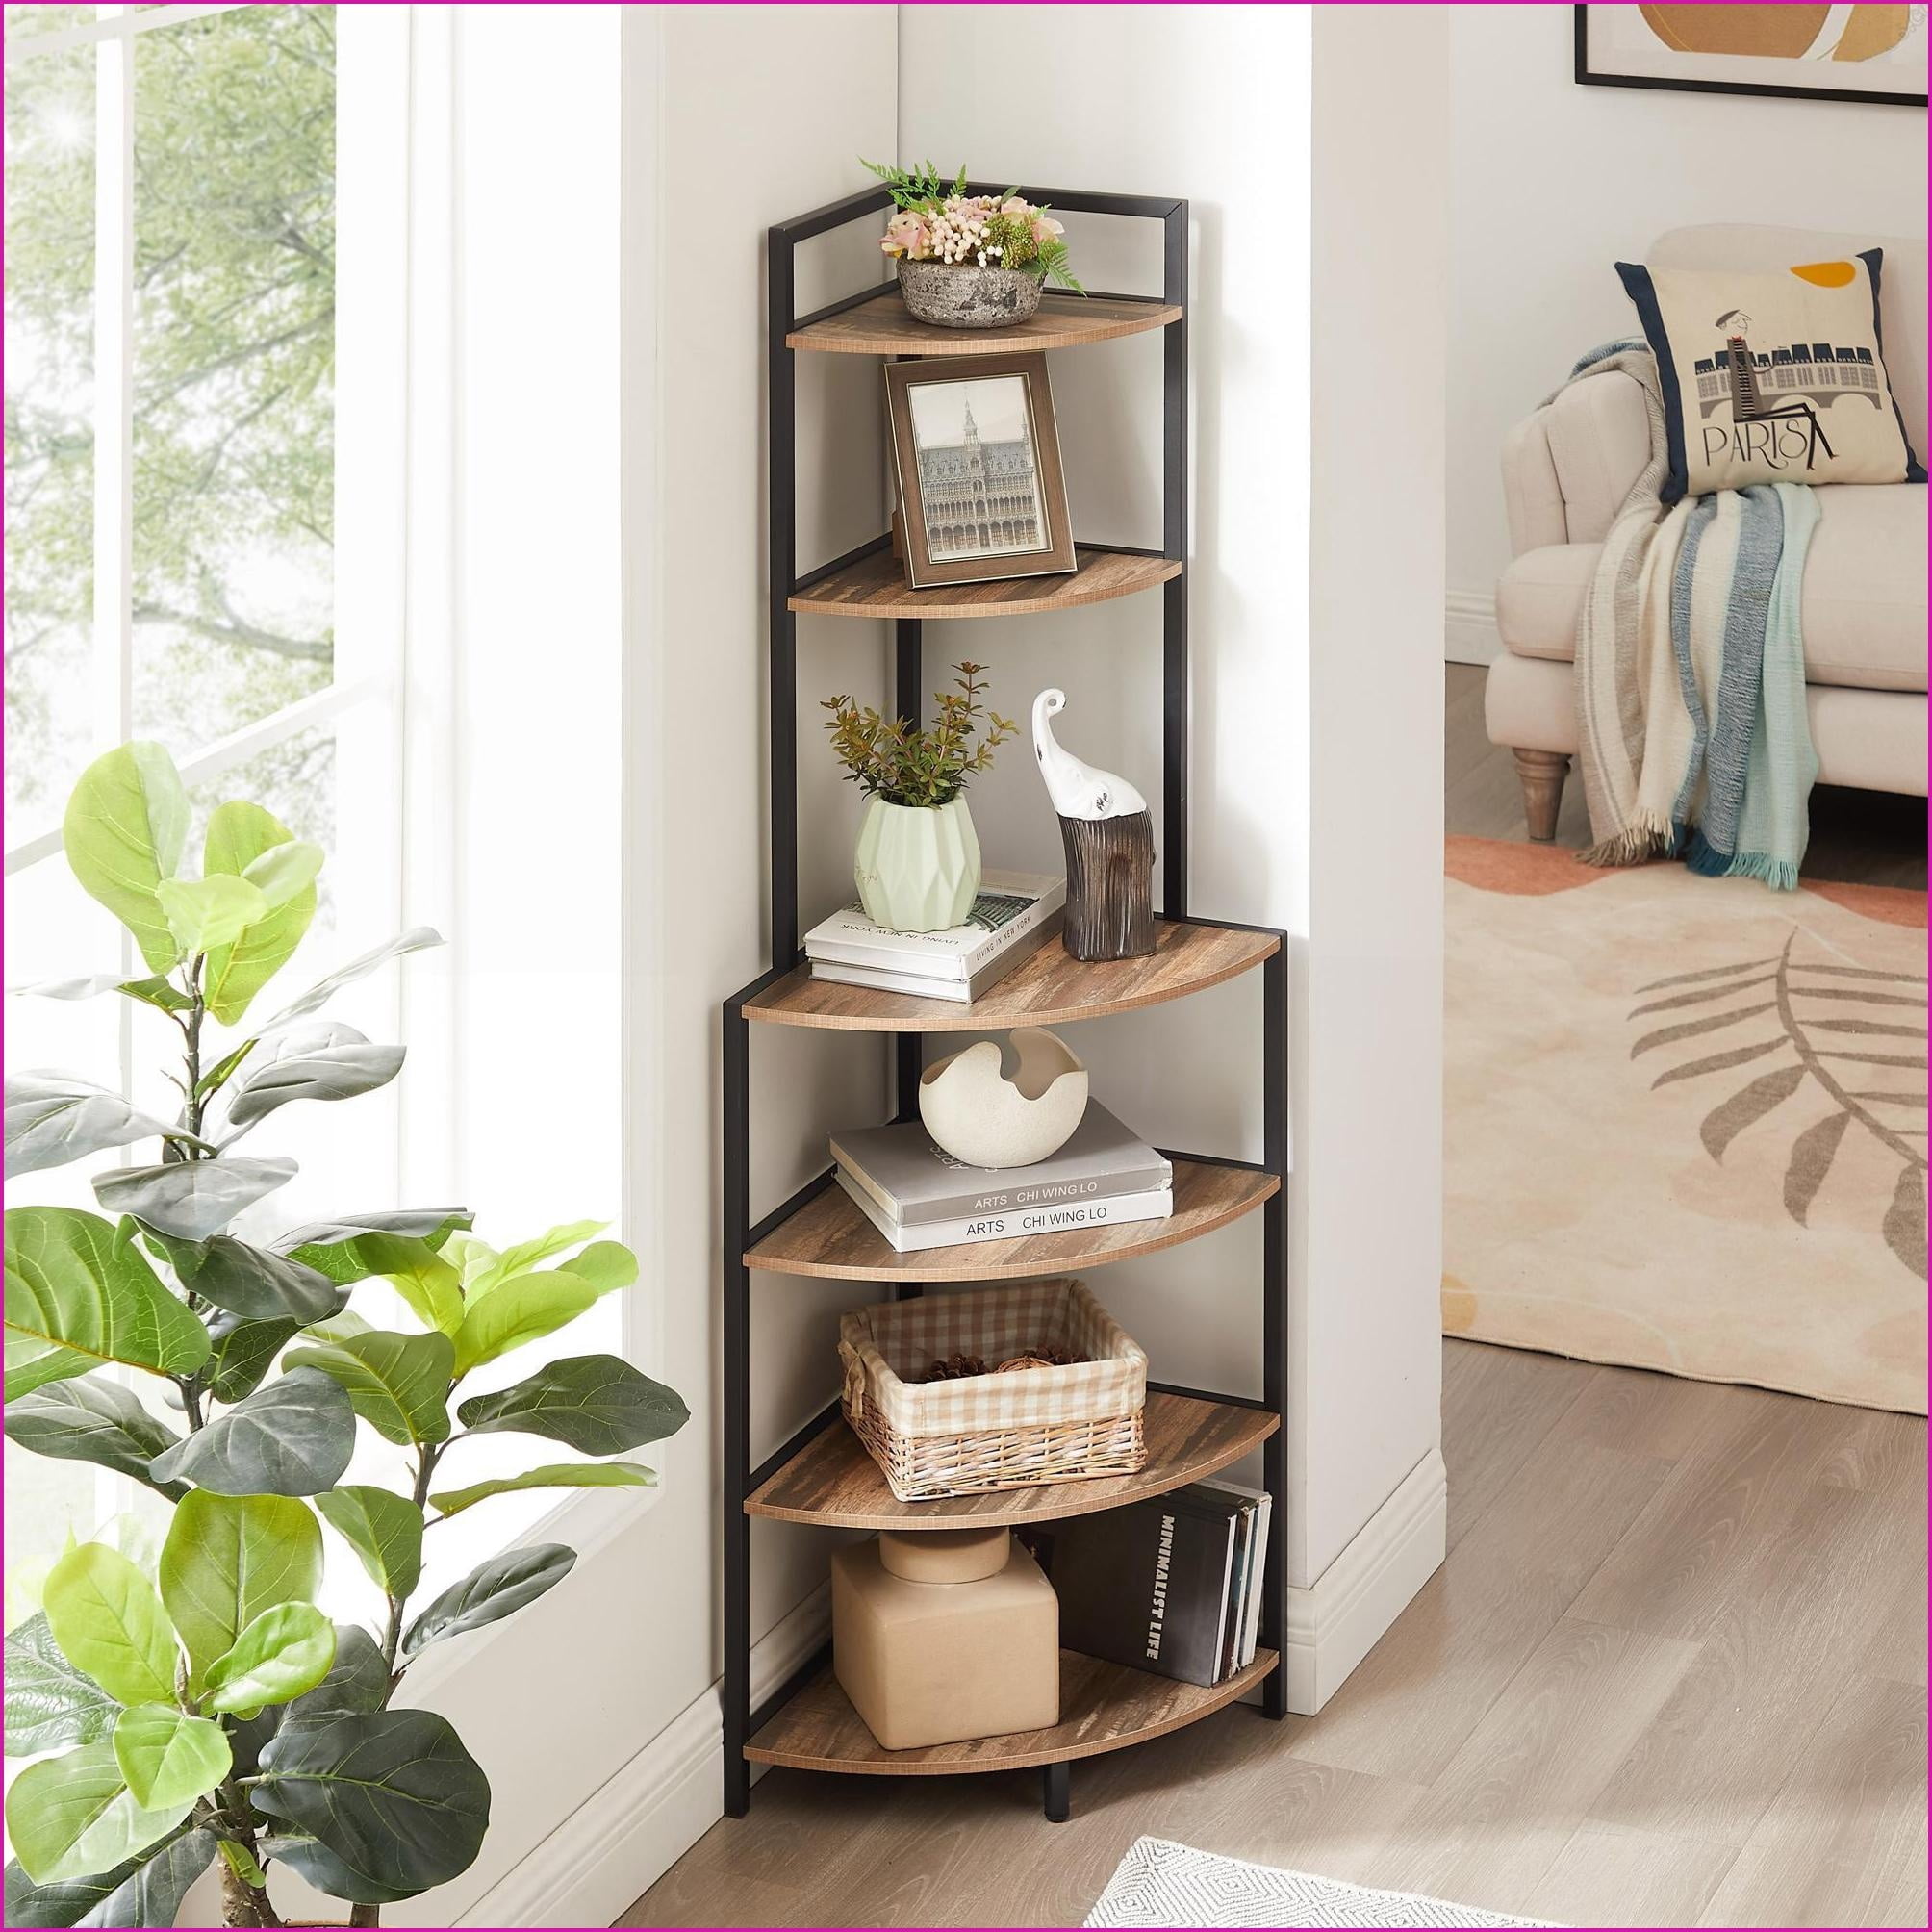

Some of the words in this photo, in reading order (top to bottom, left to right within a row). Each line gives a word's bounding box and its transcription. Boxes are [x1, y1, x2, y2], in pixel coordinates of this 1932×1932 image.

[1702, 419, 1809, 470] PARIS
[840, 924, 872, 932] YORK
[976, 942, 995, 961] LIVING
[995, 937, 1003, 946] IN
[1003, 928, 1015, 940] NEW
[1016, 915, 1031, 930] YORK
[974, 1195, 1008, 1209] ARTS
[1016, 1189, 1039, 1203] CHI
[1042, 1184, 1078, 1199] WING
[1080, 1182, 1098, 1194] LO
[966, 1219, 1004, 1236] ARTS
[1022, 1214, 1045, 1229] CHI
[1049, 1209, 1085, 1225] WING
[1089, 1207, 1107, 1220] LO
[1151, 1514, 1175, 1619] MINIMALIST
[1146, 1621, 1162, 1660] LIFE
